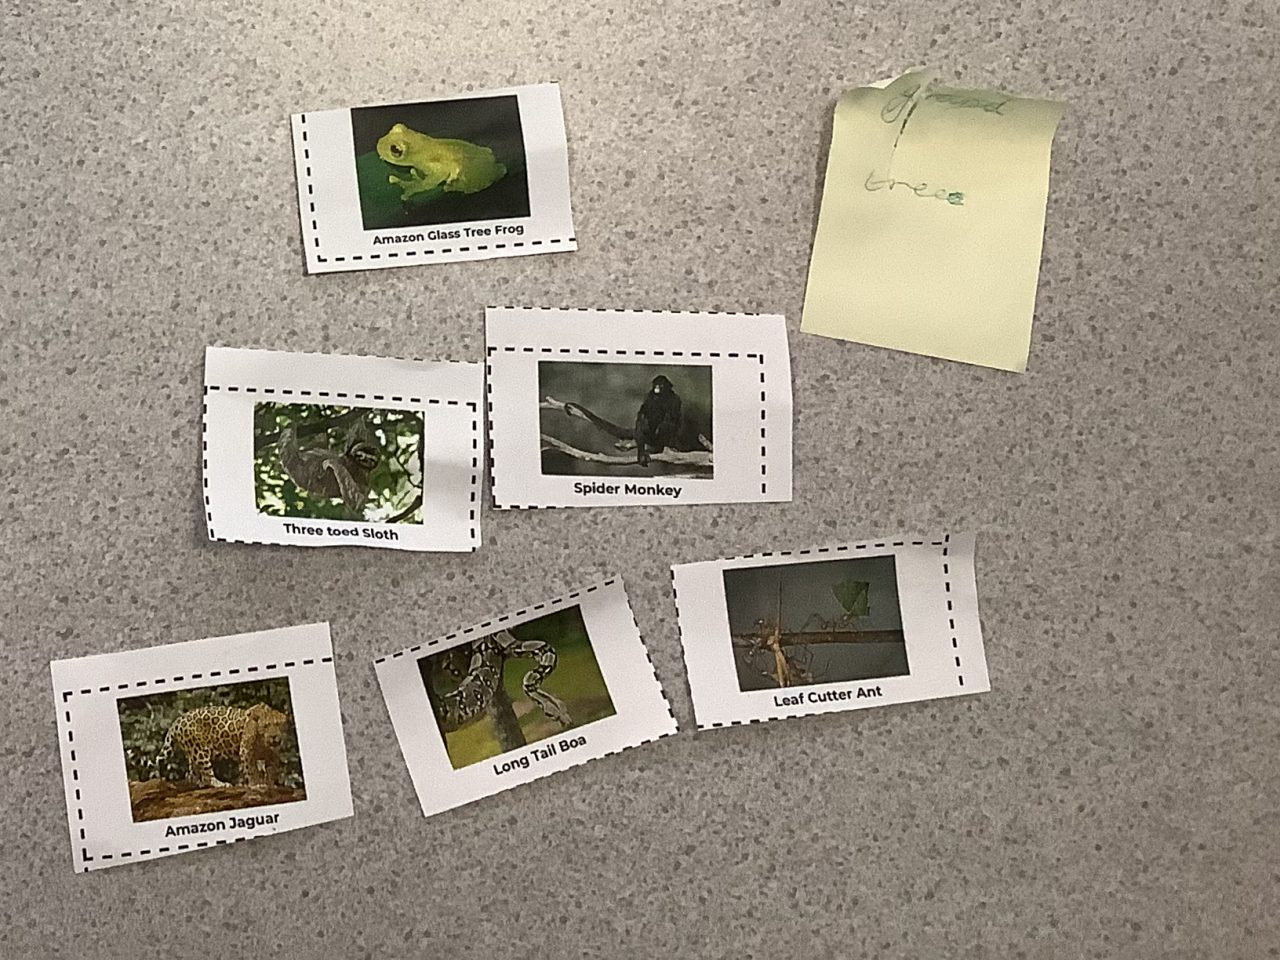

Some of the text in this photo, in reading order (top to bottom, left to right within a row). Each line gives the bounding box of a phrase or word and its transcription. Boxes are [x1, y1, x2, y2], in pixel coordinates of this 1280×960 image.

[373, 224, 525, 245] Amazon Glass Tree Frog
[574, 481, 682, 499] Spider Monkey
[283, 523, 399, 541] Three toed Sloth
[773, 685, 883, 707] Leaf Cutter Ant
[493, 735, 588, 776] Long Tail Boa
[165, 813, 280, 838] Amazon Jaguar
